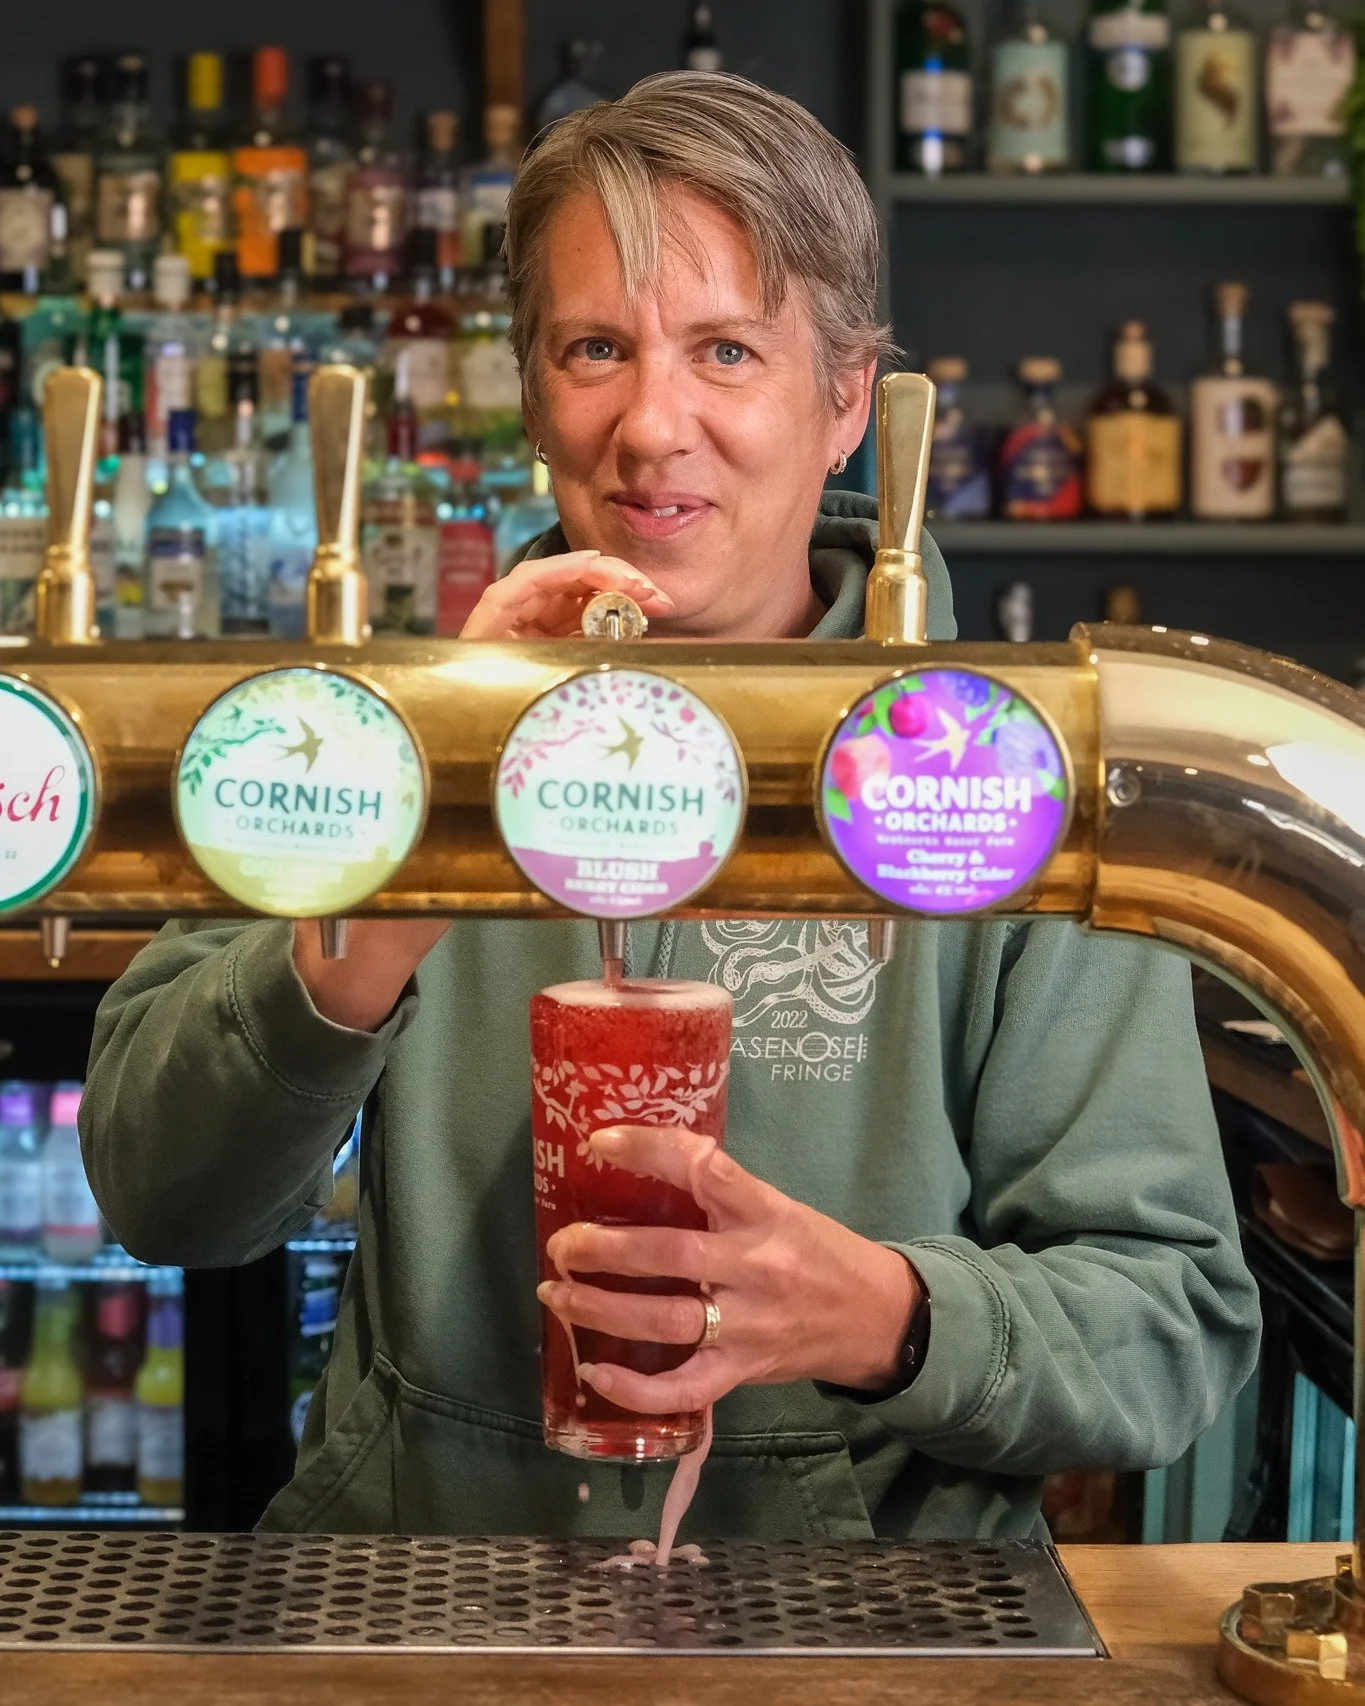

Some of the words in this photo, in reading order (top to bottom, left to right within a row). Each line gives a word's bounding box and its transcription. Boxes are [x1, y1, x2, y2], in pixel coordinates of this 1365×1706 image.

[214, 777, 382, 820] CORNISH
[537, 779, 704, 816] CORNISH
[860, 774, 1032, 813] CORNISH
[236, 814, 355, 839] ORCHARDS
[560, 815, 679, 835] ORCHARDS
[884, 811, 1007, 833] ORCHARDS
[771, 1010, 808, 1029] 2022
[771, 1063, 854, 1082] FRINGE
